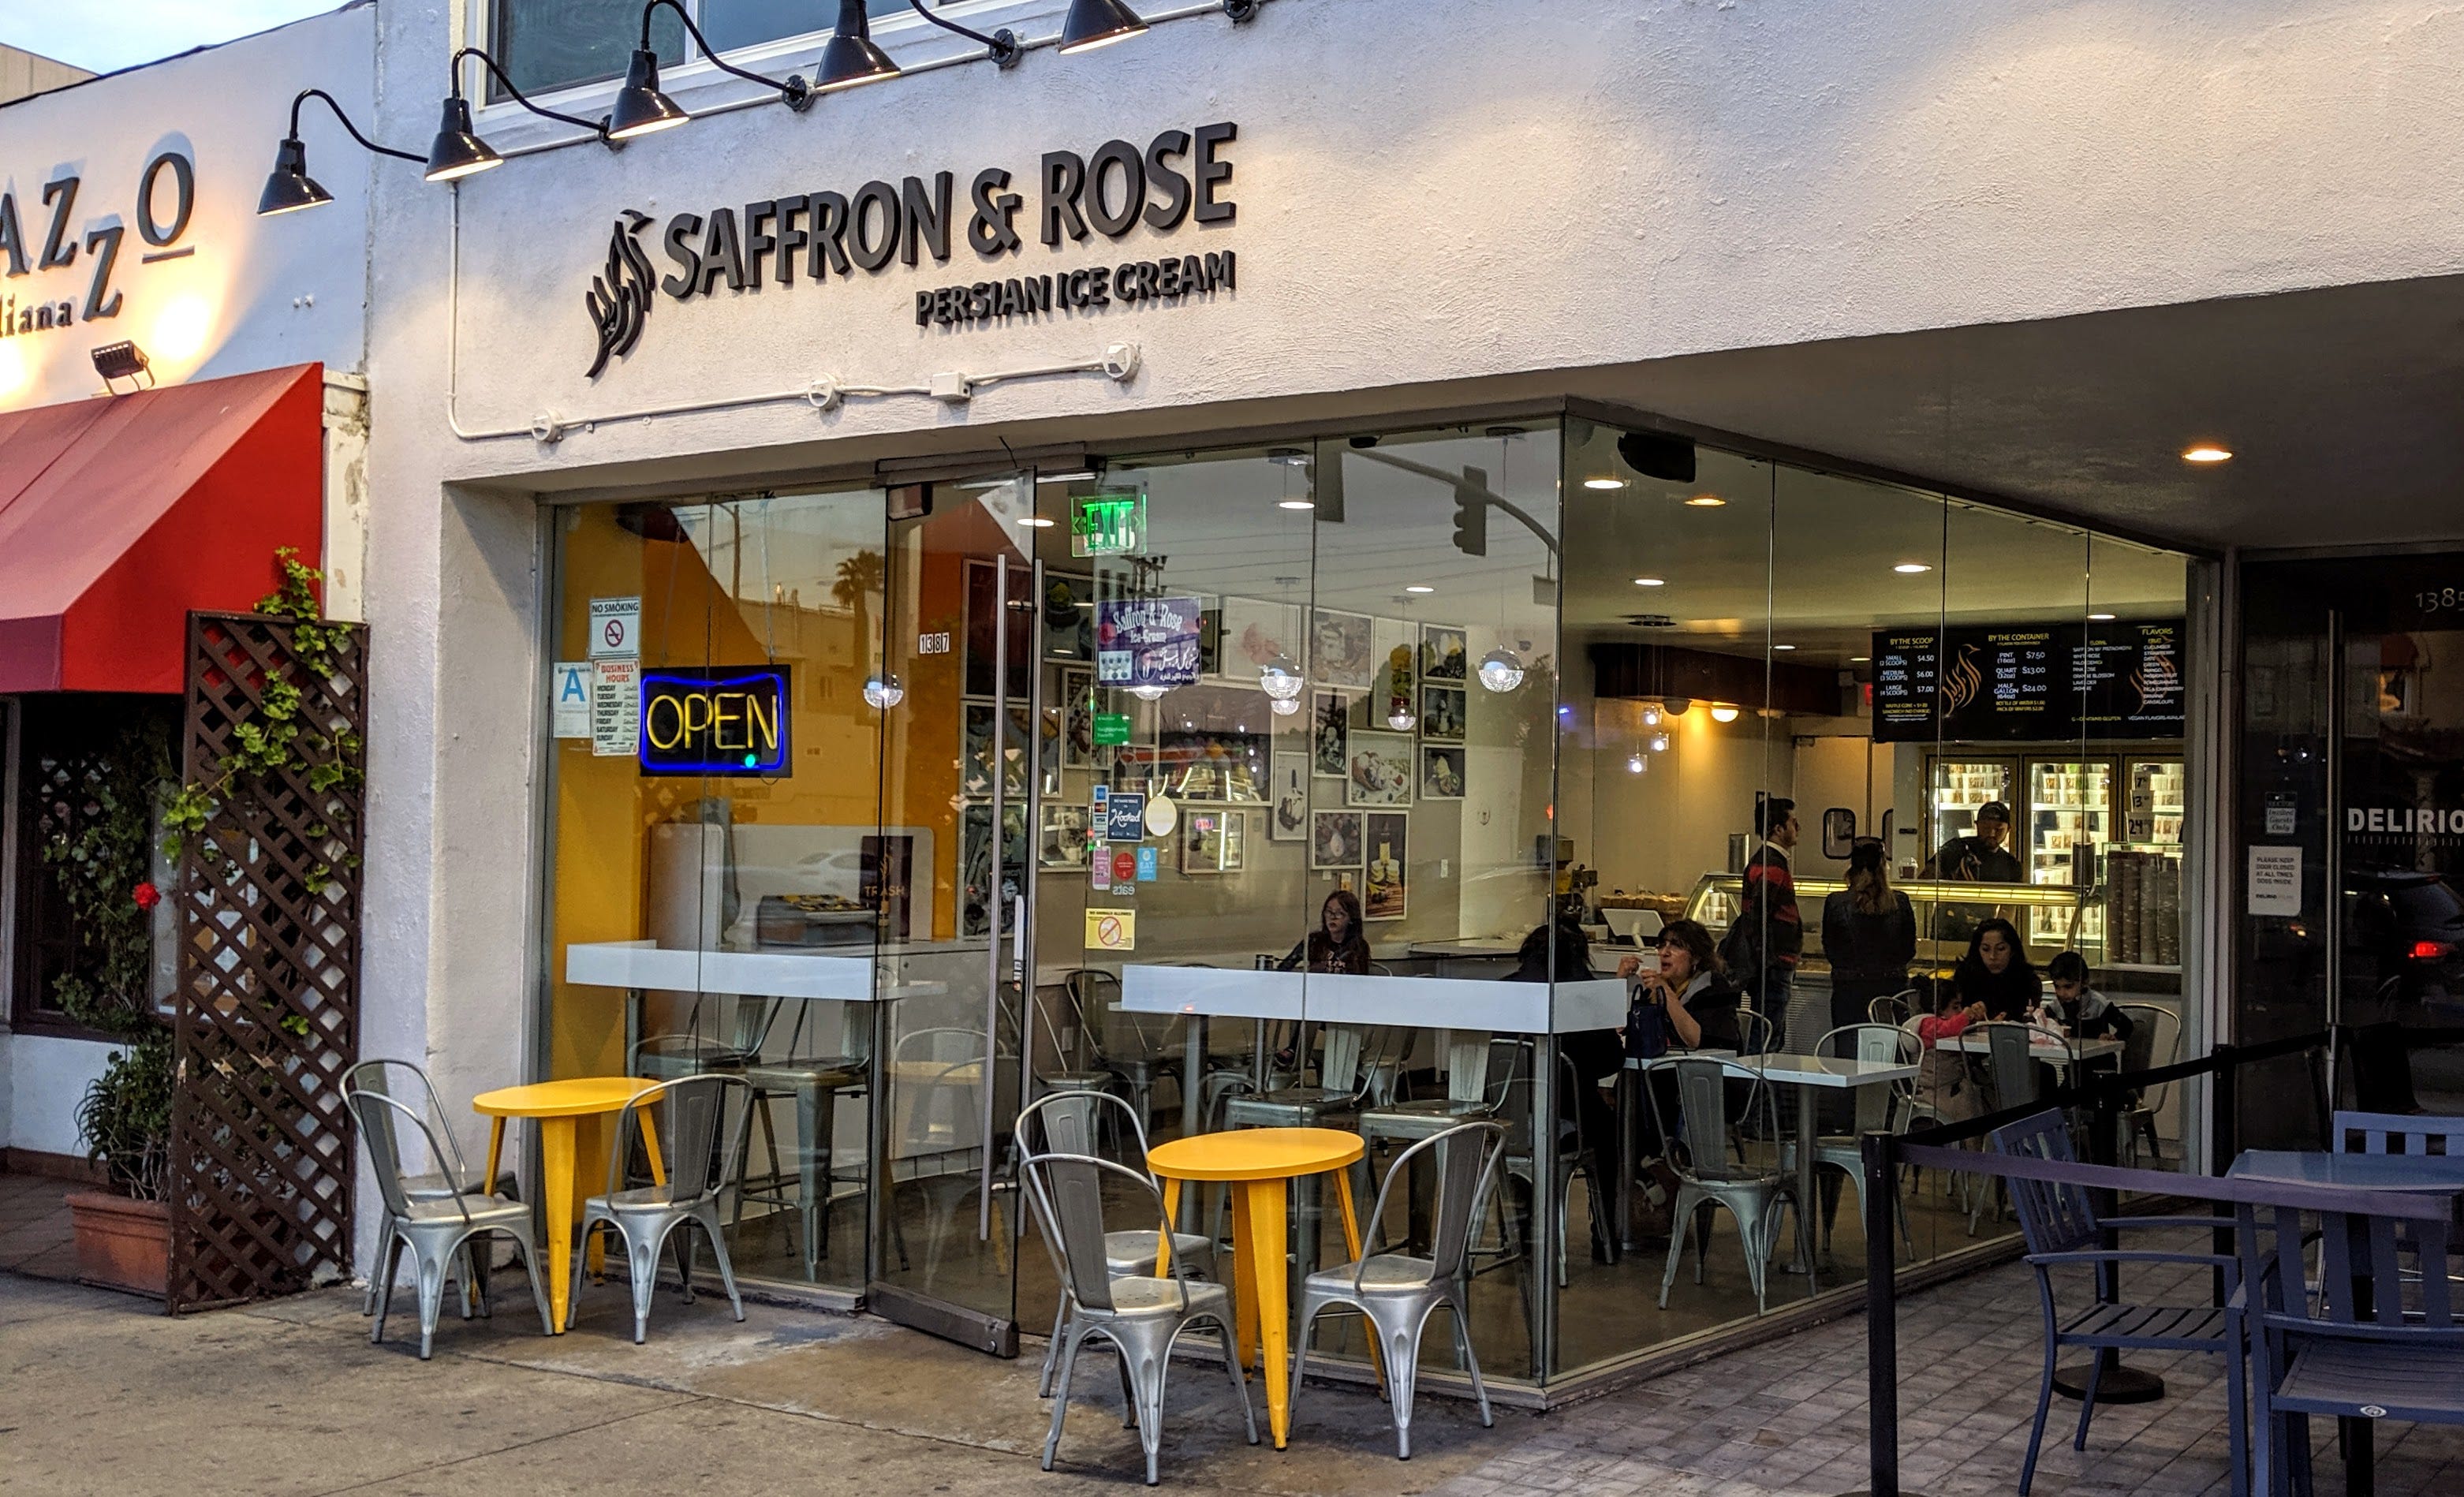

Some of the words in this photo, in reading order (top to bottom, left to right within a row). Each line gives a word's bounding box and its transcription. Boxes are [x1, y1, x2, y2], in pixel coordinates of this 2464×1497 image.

[663, 170, 953, 300] SAFFRON
[968, 167, 1024, 256] &
[1040, 121, 1238, 246] ROSE
[915, 274, 1052, 327] PERSIAN
[1057, 266, 1110, 310] ICE
[1112, 250, 1236, 302] CREAM
[1082, 500, 1136, 550] EXIT
[592, 604, 603, 613] NO
[604, 602, 639, 613] SMOKING
[1113, 606, 1146, 634] Saffron
[1148, 603, 1157, 627] &
[1159, 603, 1183, 632] Rose
[921, 634, 949, 652] 1387
[1912, 637, 1934, 645] SCOOP
[2011, 633, 2050, 641] CONTAINER
[601, 664, 634, 673] BUSINESS
[2022, 666, 2046, 675] $13.00
[561, 667, 586, 702] A
[606, 674, 630, 683] HOURS
[647, 693, 778, 750] OPEN
[1109, 808, 1142, 828] Hooked
[2347, 807, 2464, 834] DELIRIO
[864, 885, 905, 897] TRASH
